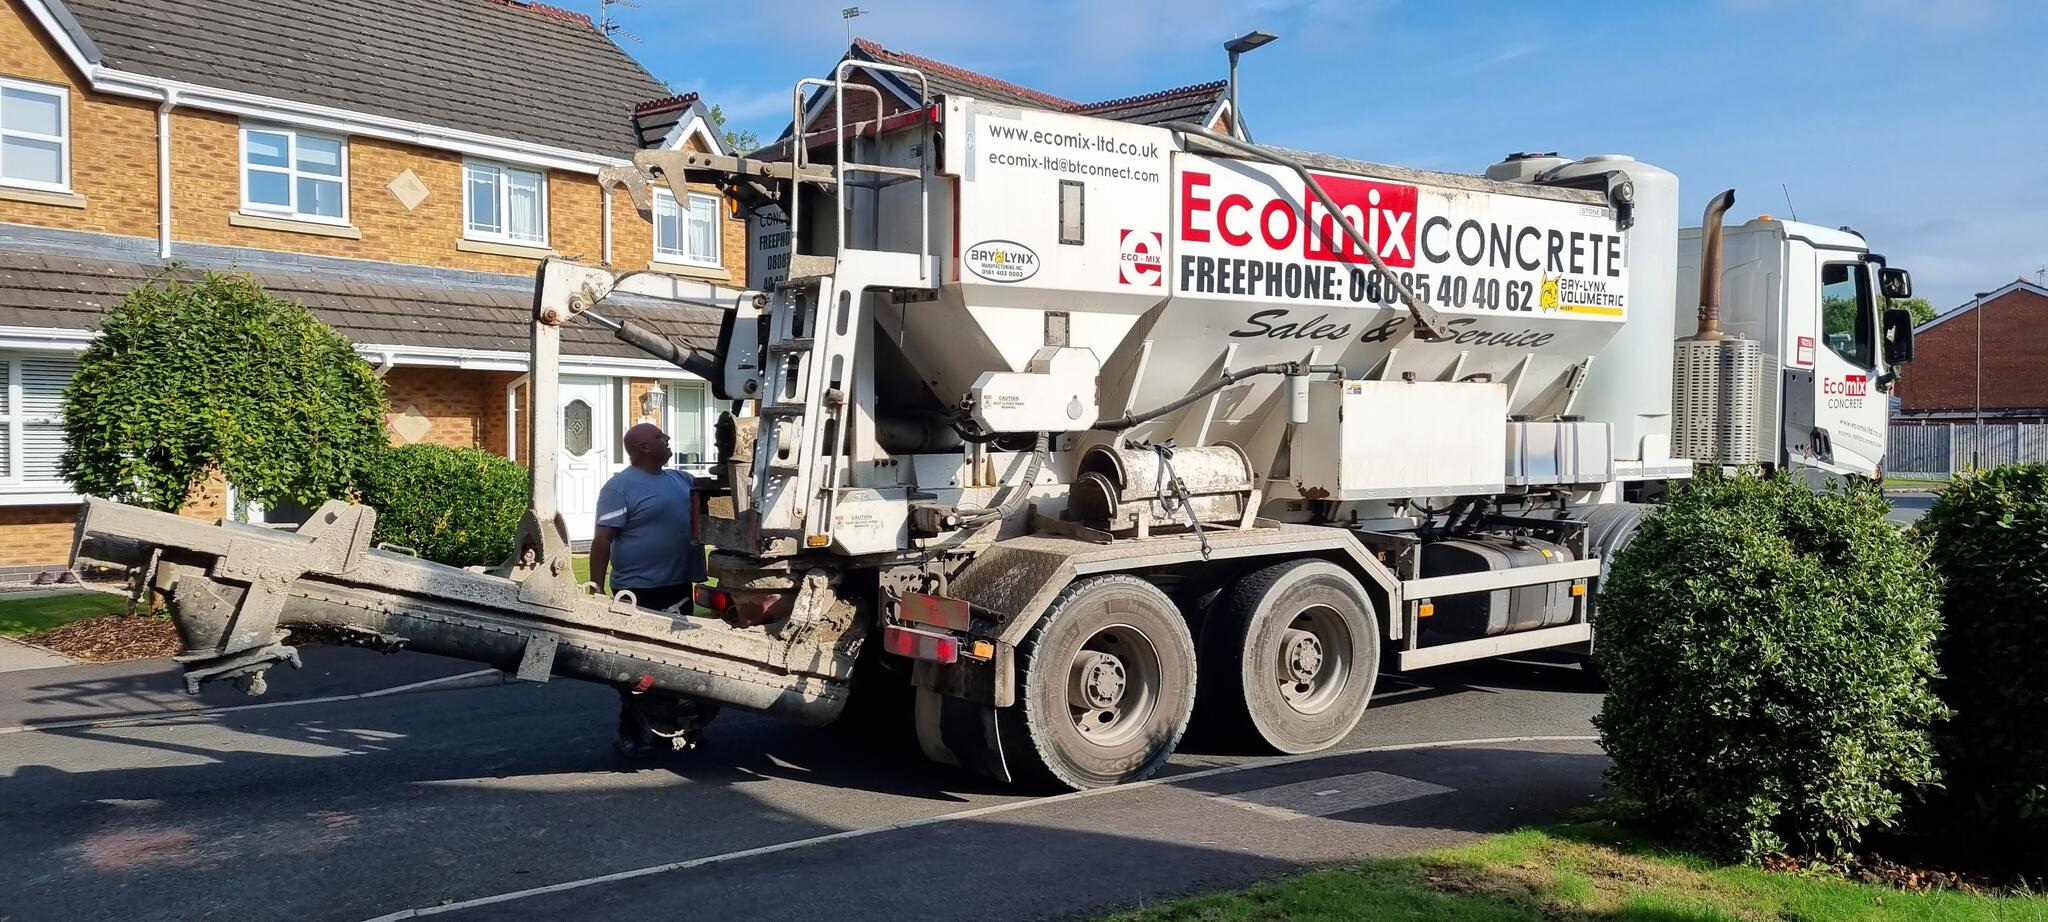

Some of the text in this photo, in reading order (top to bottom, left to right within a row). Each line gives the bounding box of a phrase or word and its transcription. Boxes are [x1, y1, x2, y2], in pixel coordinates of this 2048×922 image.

[989, 124, 1158, 159] www.ecomix-ltd.co.uk
[989, 152, 1159, 183] ecomix-ltd@btconnect.com
[1581, 207, 1600, 216] STONE
[760, 230, 790, 251] FREEPHO
[1421, 215, 1621, 277] CONCRETE
[971, 250, 1033, 264] BAY LYNX
[1121, 253, 1138, 262] ECO
[1145, 255, 1160, 264] MIX
[1180, 254, 1343, 301] FREEPHONE:
[1437, 275, 1467, 308] 40
[1472, 277, 1500, 311] 40
[1506, 279, 1533, 312] 62
[1561, 279, 1606, 293] BAY-LYNX
[1561, 290, 1624, 307] VOLUMETRIC
[1228, 308, 1555, 348] Sales & Service
[1824, 376, 1867, 395] Ecomix
[1828, 399, 1862, 409] CONCRETE
